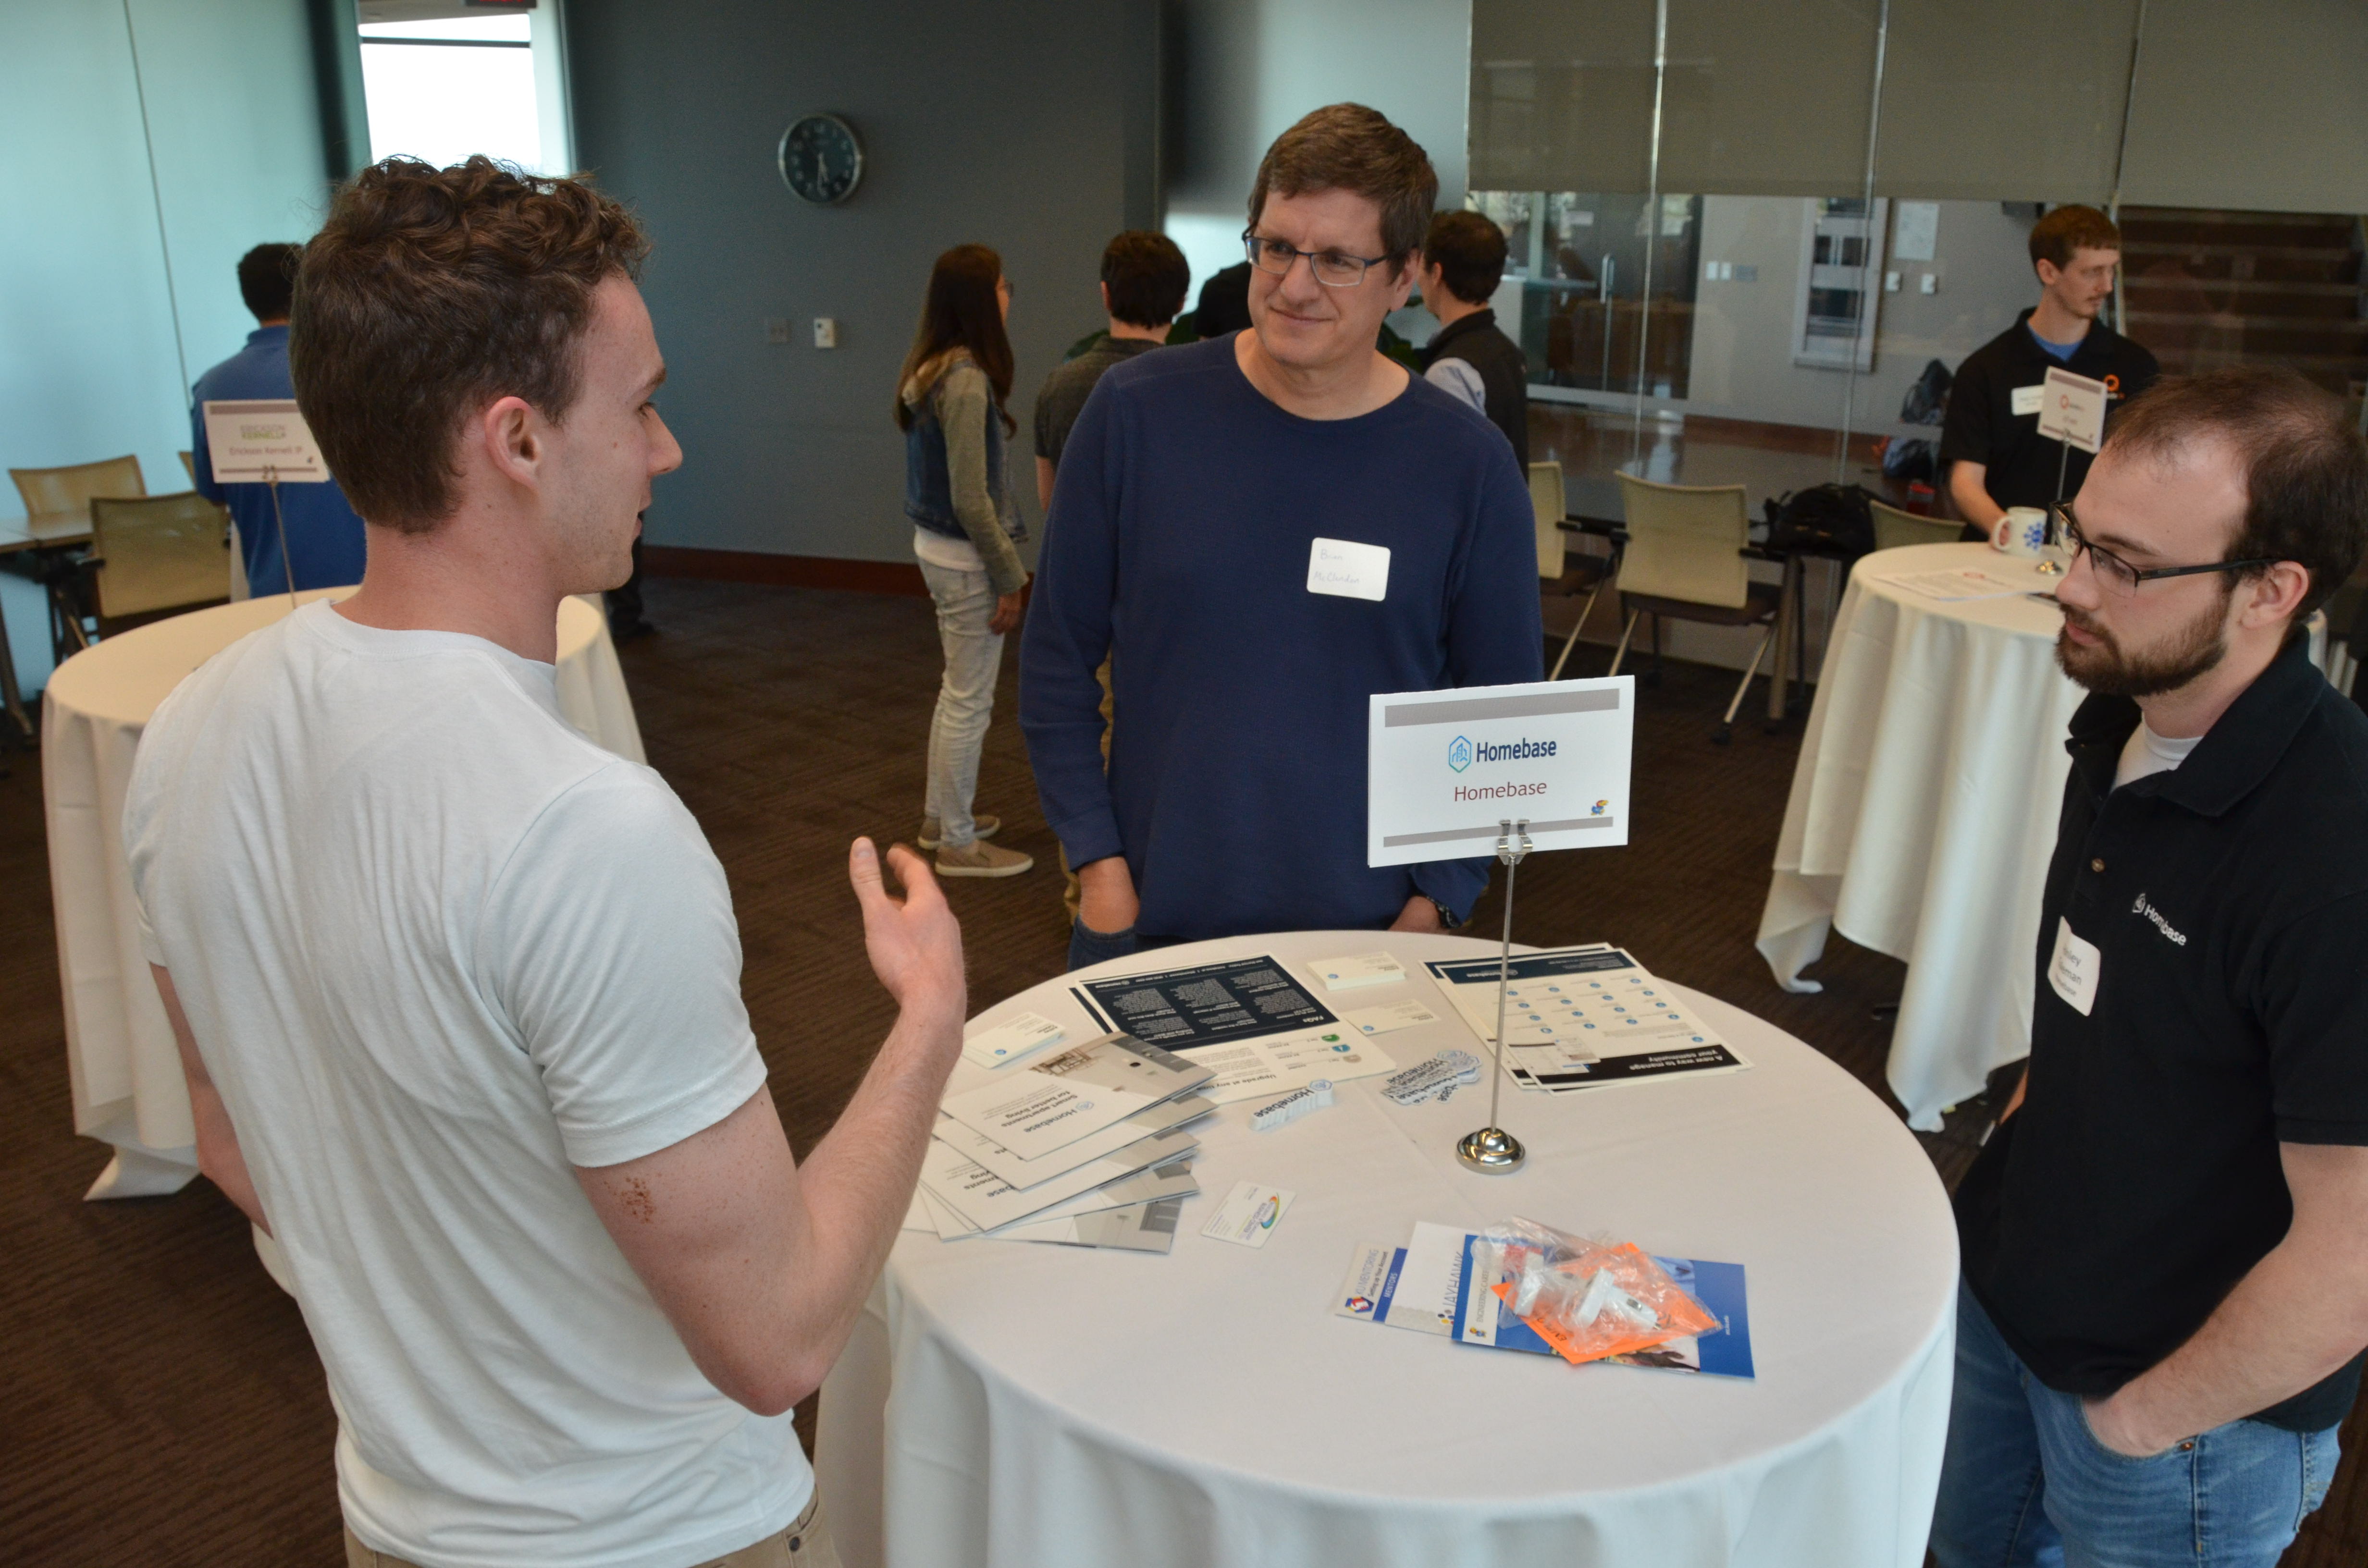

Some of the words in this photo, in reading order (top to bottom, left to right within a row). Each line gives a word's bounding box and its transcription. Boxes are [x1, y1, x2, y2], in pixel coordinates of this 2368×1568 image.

[1476, 737, 1557, 763] Homebase
[1455, 781, 1547, 802] Homebase
[1629, 1062, 1665, 1071] manage
[1649, 1053, 1697, 1063] community
[1242, 1074, 1277, 1085] Upgrade
[1031, 1096, 1058, 1110] better
[1052, 1094, 1078, 1107] Smart
[1253, 1088, 1315, 1118] Homebase
[1001, 1106, 1051, 1127] apartments
[1005, 1108, 1031, 1119] living
[1023, 1109, 1077, 1133] Homebase
[1384, 1272, 1398, 1298] MENTORS
